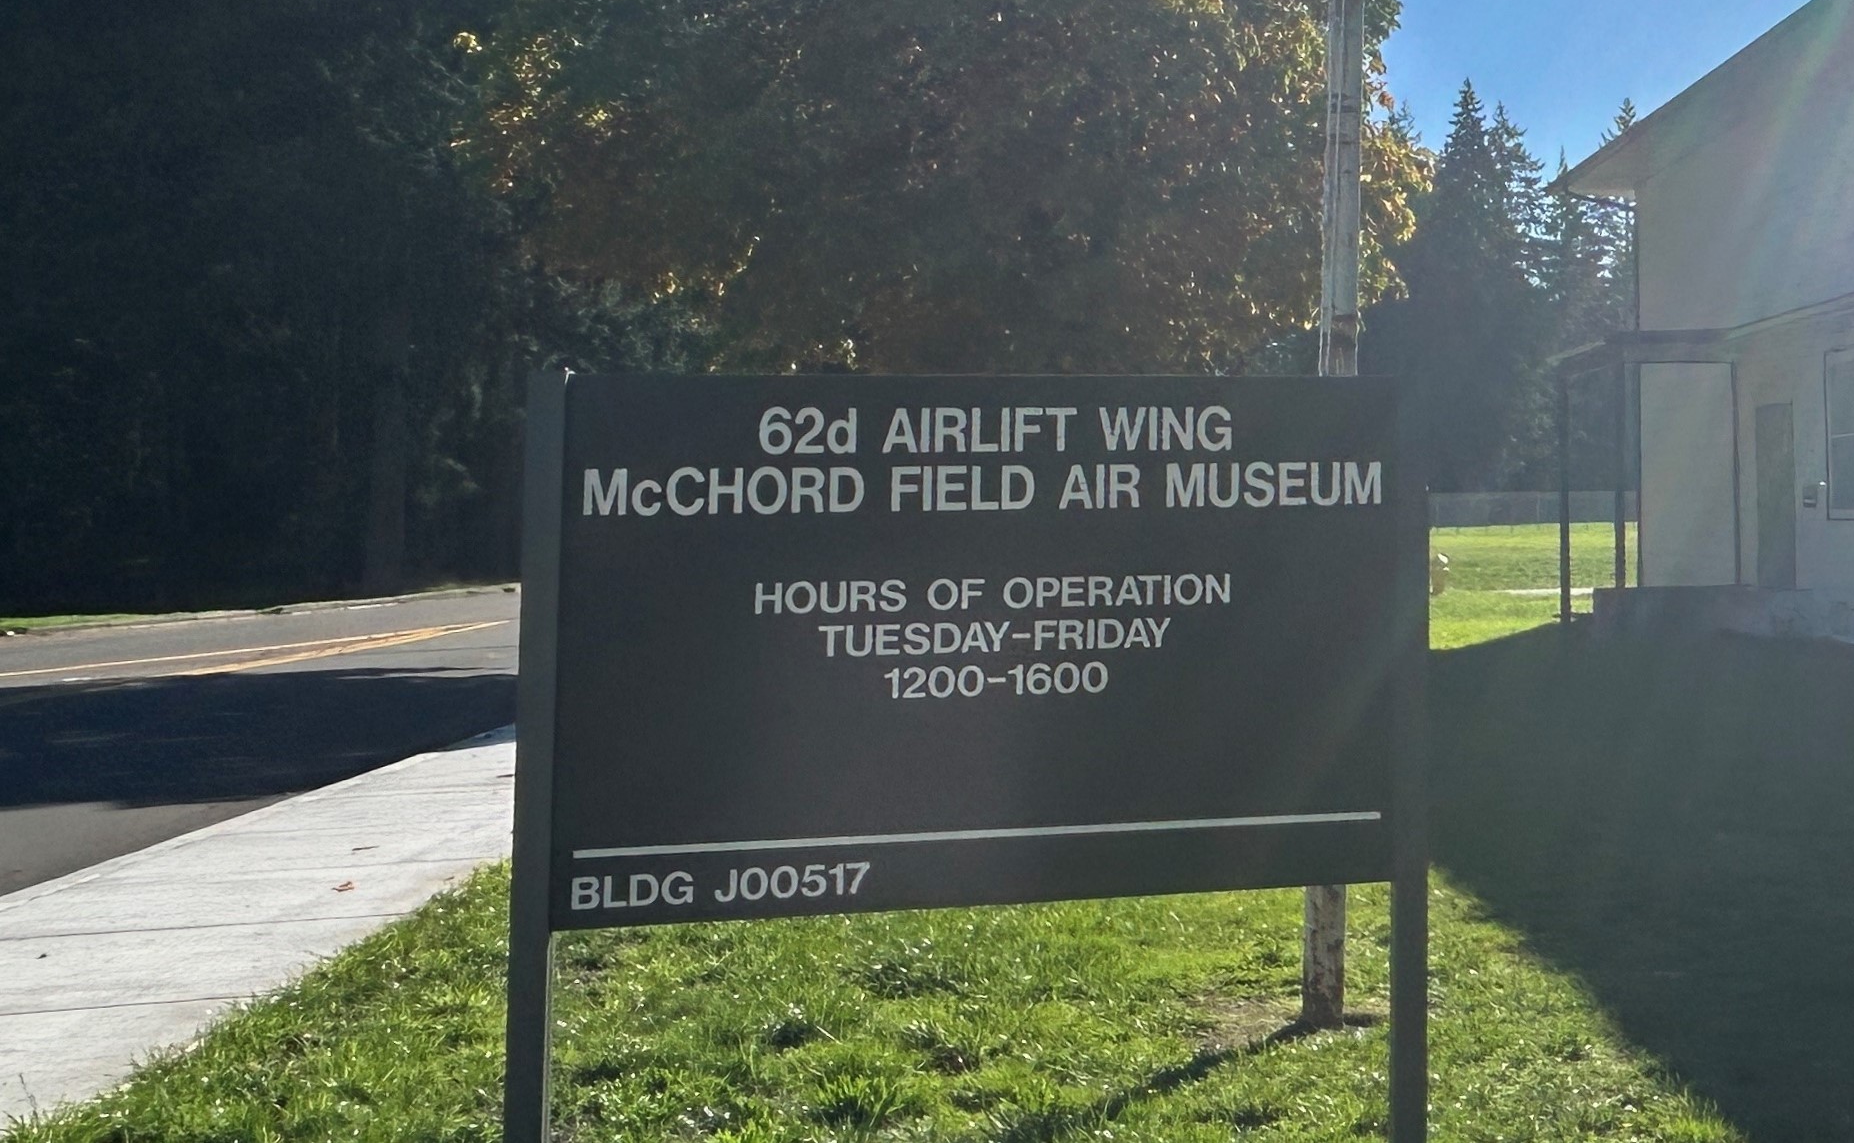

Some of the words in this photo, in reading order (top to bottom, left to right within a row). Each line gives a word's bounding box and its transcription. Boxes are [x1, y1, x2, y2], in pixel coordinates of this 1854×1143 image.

[758, 406, 857, 455] 62d
[882, 407, 1078, 454] AIRLIFT
[1098, 405, 1233, 452] WING
[582, 466, 865, 517] McCHORD
[889, 464, 1035, 512] FIELD
[1058, 463, 1142, 510] AIR
[1165, 460, 1383, 508] MUSEUM
[754, 579, 907, 615] HOURS
[927, 578, 986, 611] OF
[1002, 573, 1232, 609] OPERATION
[817, 617, 1171, 658] TUESDAY-FRIDAY
[883, 661, 1109, 699] 1200-1600
[570, 871, 694, 910] BLDG
[714, 861, 871, 903] J00517
